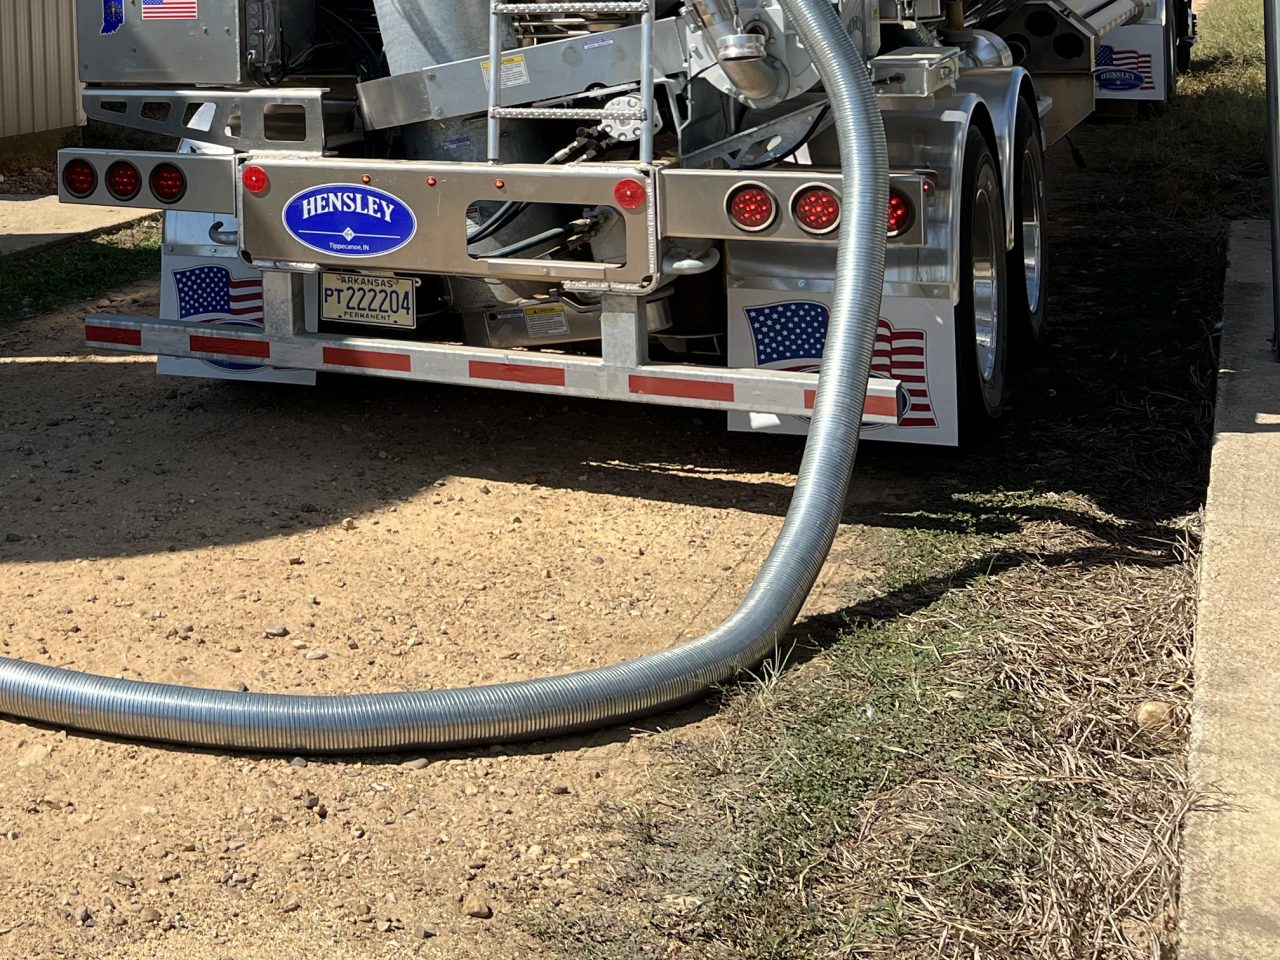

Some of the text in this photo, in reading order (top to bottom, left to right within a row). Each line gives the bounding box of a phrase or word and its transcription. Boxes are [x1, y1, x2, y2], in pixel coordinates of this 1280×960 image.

[302, 192, 395, 223] HENSLEY
[340, 276, 394, 288] ARKANSAS
[343, 311, 391, 321] PERMANENT
